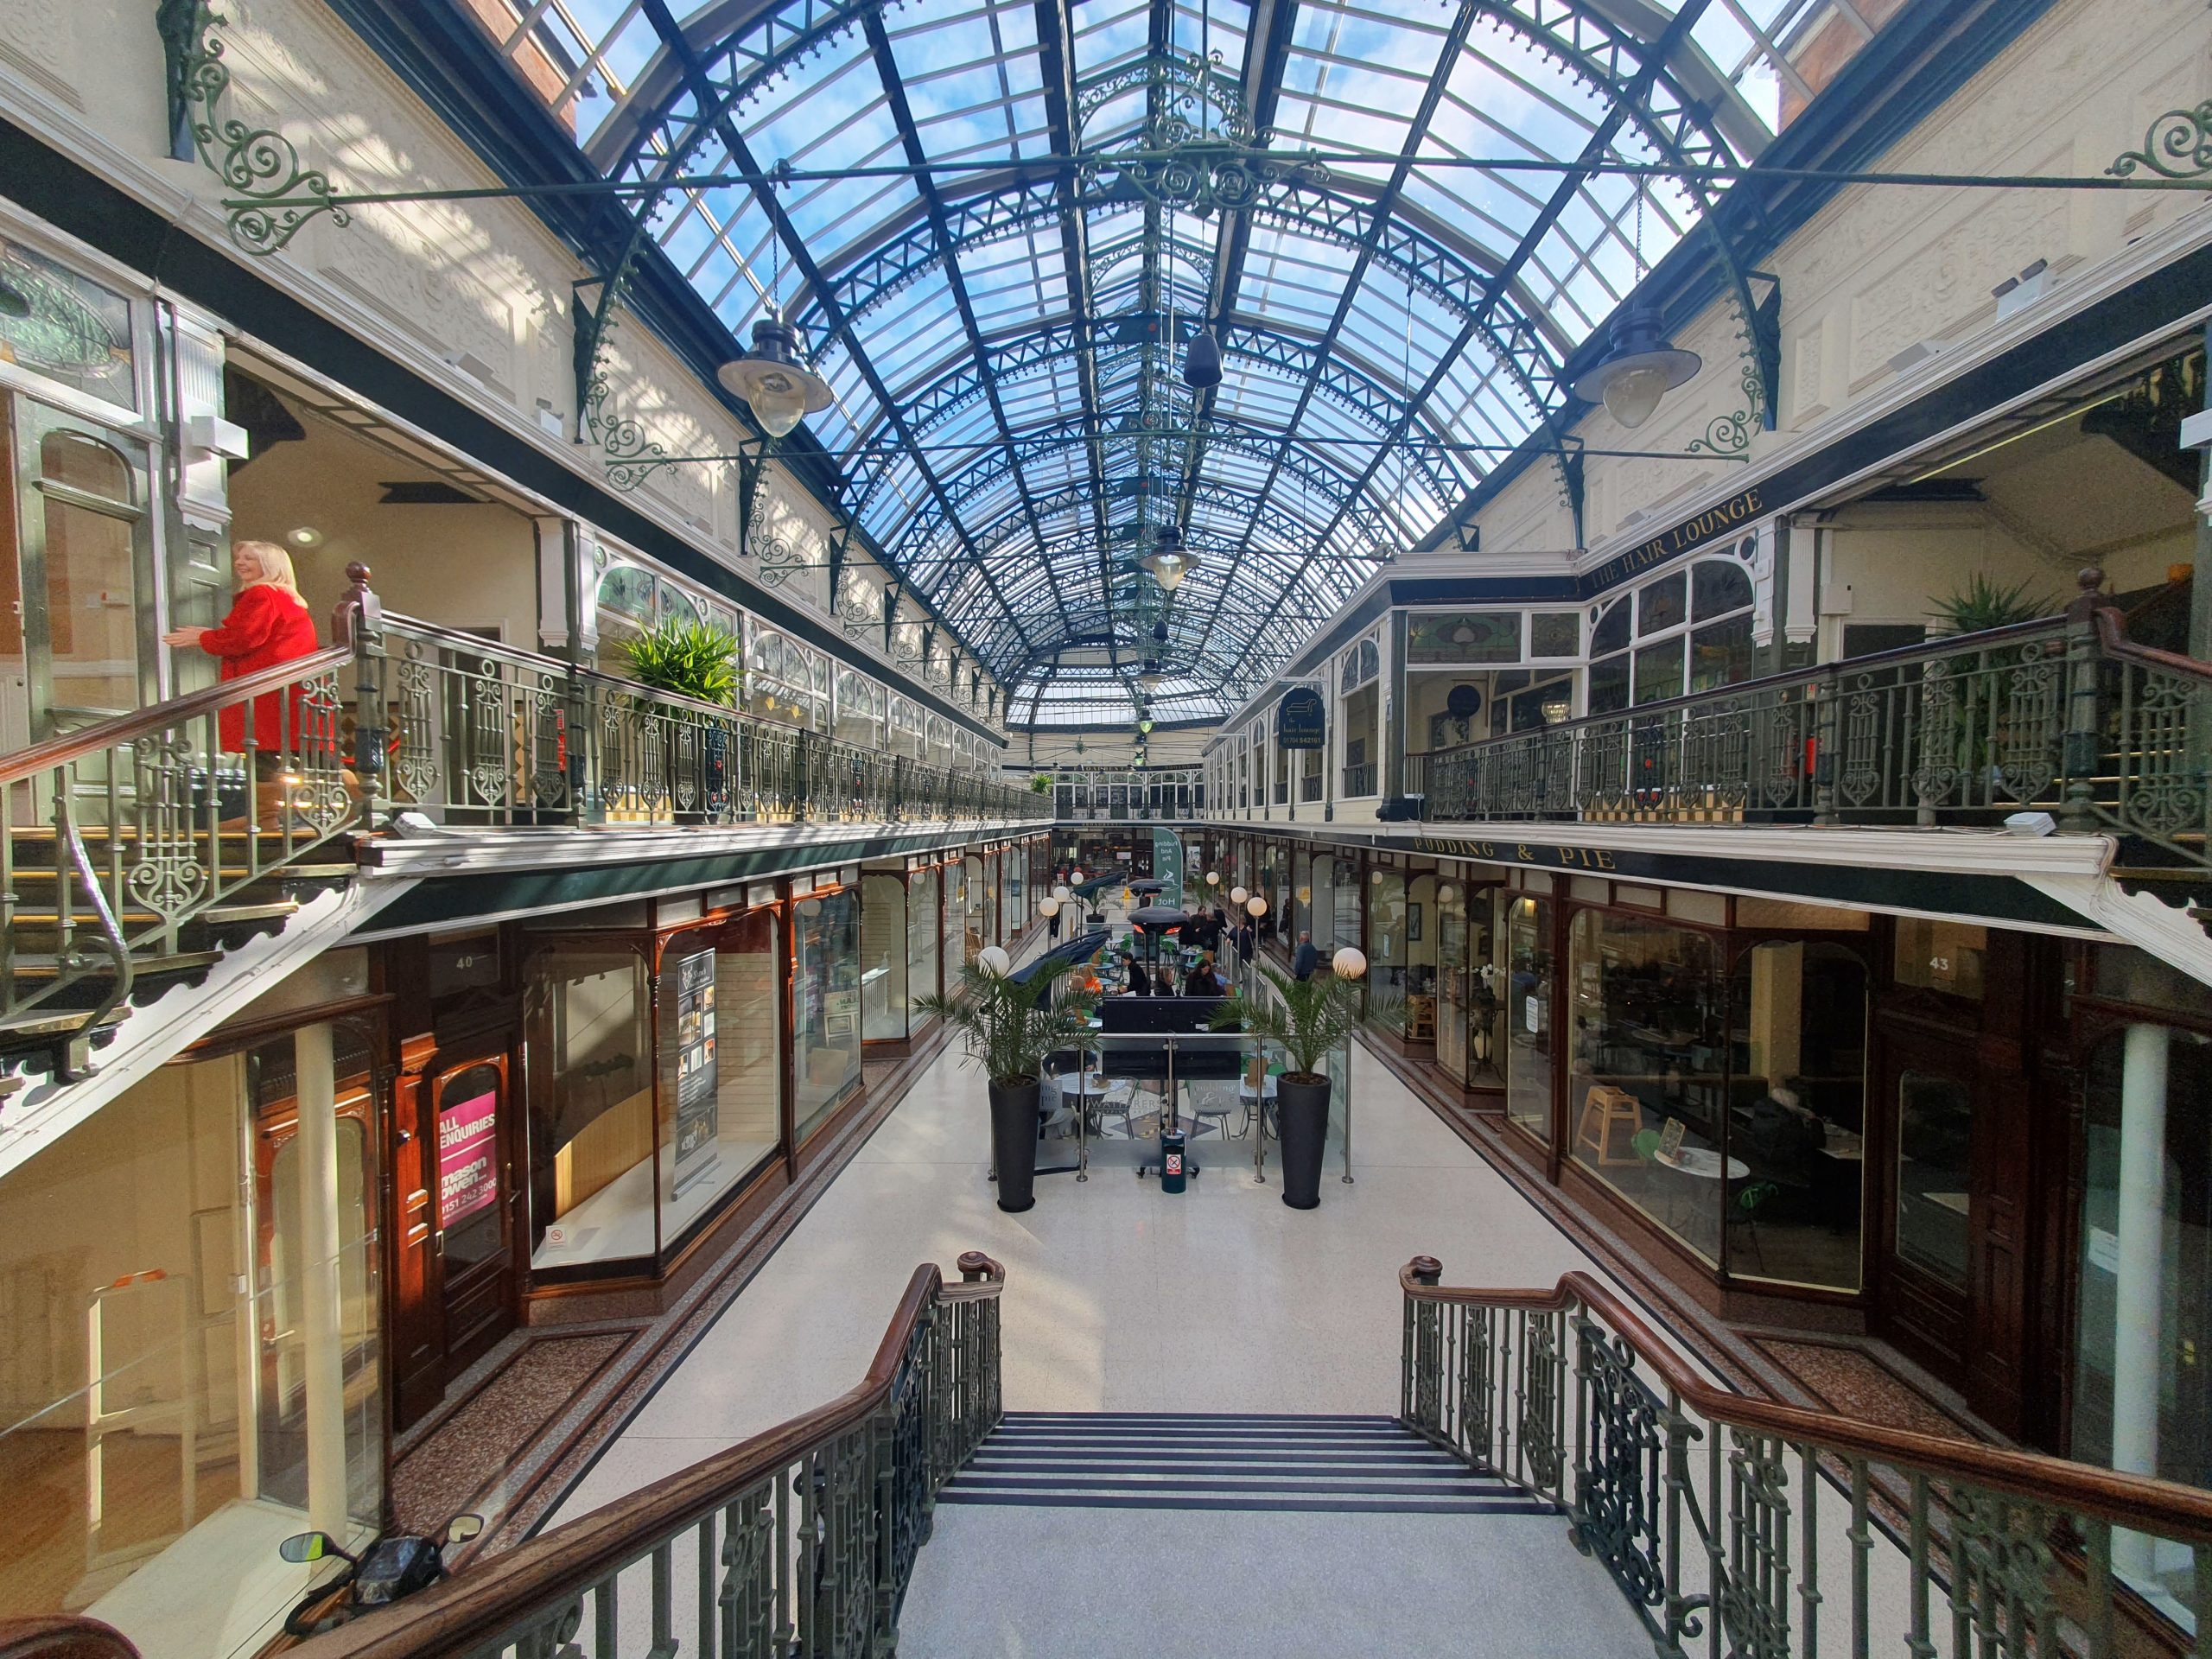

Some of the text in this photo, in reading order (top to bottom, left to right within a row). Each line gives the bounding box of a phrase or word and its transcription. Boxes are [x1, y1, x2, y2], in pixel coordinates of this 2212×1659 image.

[1591, 488, 1763, 588] THE HAIR LOUNGE
[1414, 837, 1616, 869] PUDDING & PIE
[456, 956, 473, 969] 40
[1929, 957, 1948, 970] 43
[1090, 1099, 1160, 1109] WAYFARERS
[440, 1116, 460, 1135] ALL
[440, 1113, 495, 1149] ENQUIRIES
[441, 1156, 487, 1188] mason
[461, 1188, 477, 1204] 242
[478, 1177, 497, 1196] 3000
